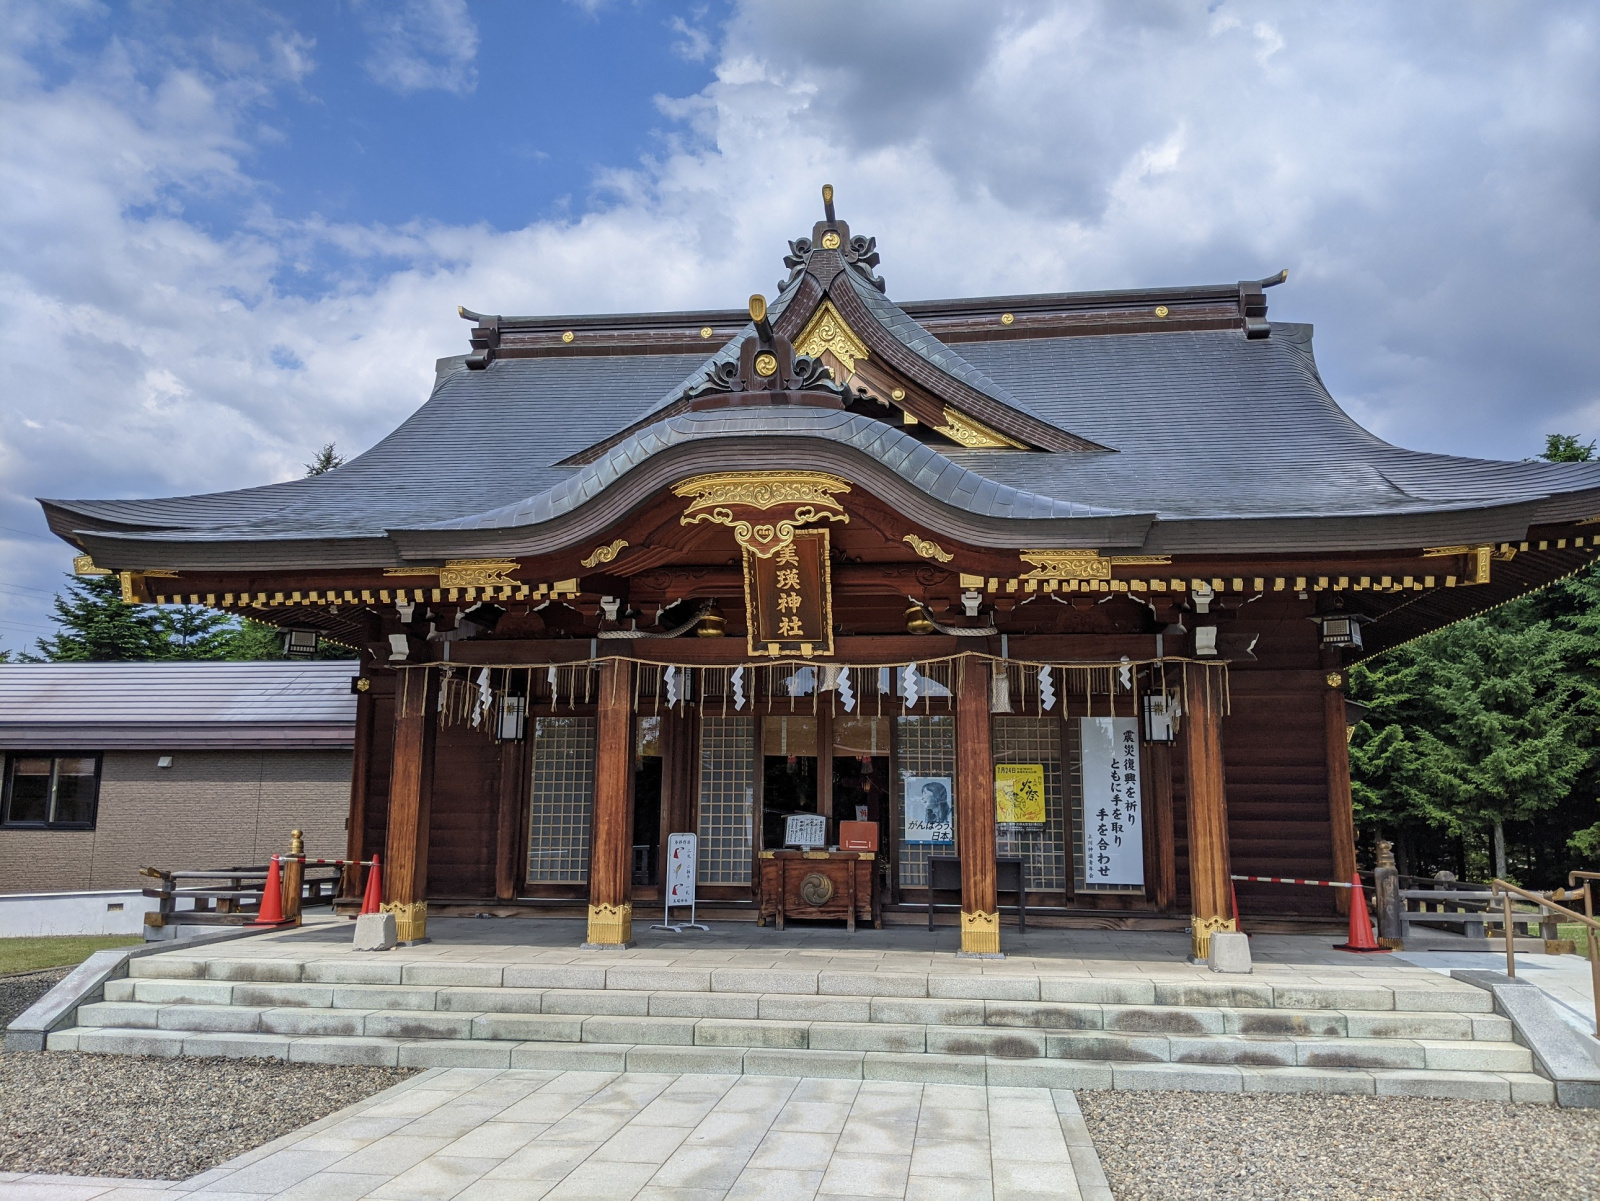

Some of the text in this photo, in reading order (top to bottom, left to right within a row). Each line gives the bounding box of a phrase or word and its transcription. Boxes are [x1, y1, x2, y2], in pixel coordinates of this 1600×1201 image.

[776, 543, 804, 637] 美瑛神社
[1111, 758, 1124, 847] ともに手を取り
[1123, 730, 1137, 826] 震災復興を祈り
[908, 821, 954, 830] がんばろう、
[932, 832, 952, 841] 日本。
[1096, 808, 1110, 876] 手を合わせ
